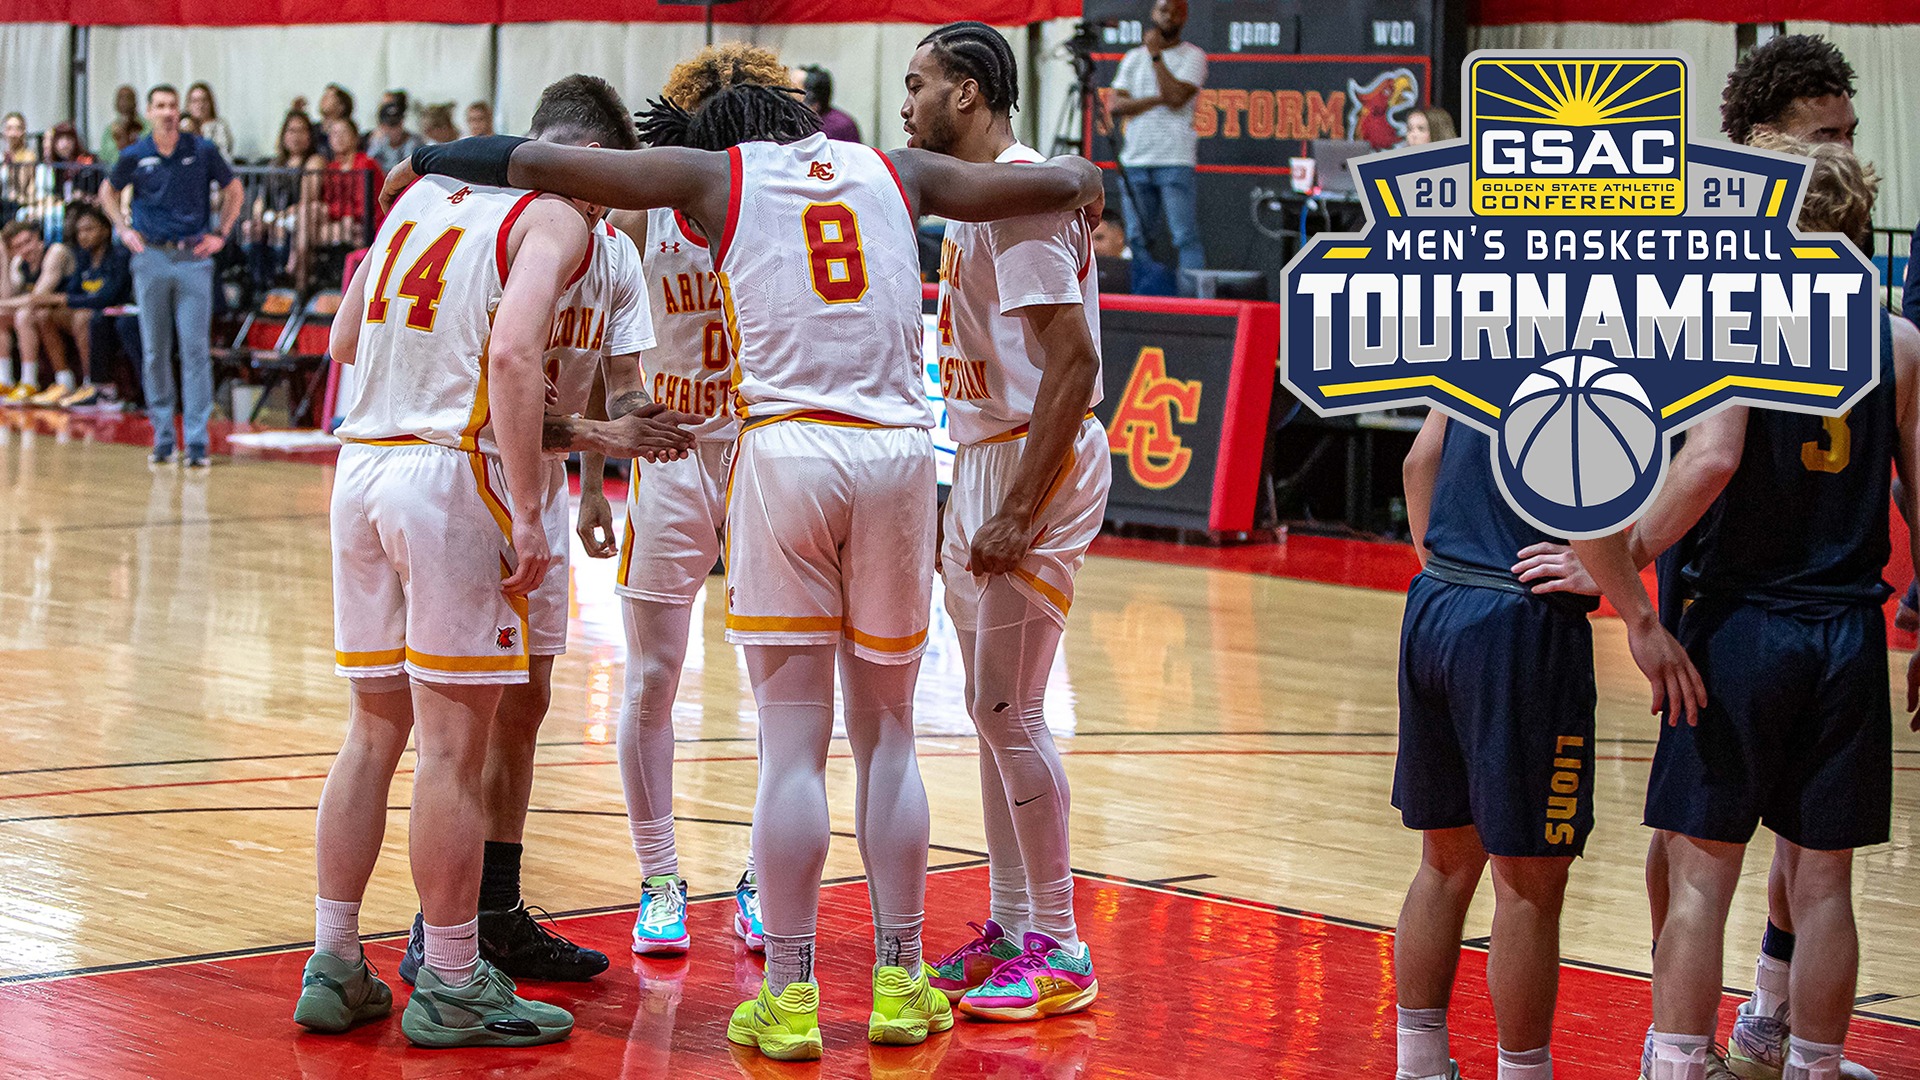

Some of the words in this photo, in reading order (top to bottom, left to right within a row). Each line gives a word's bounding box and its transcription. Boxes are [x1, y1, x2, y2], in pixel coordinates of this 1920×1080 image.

[1229, 21, 1281, 52] game
[1373, 20, 1416, 46] won
[366, 220, 466, 333] 14
[801, 201, 870, 305] 8
[702, 319, 731, 371] 0
[1801, 408, 1851, 474] 3
[1544, 735, 1585, 845] LIONS
